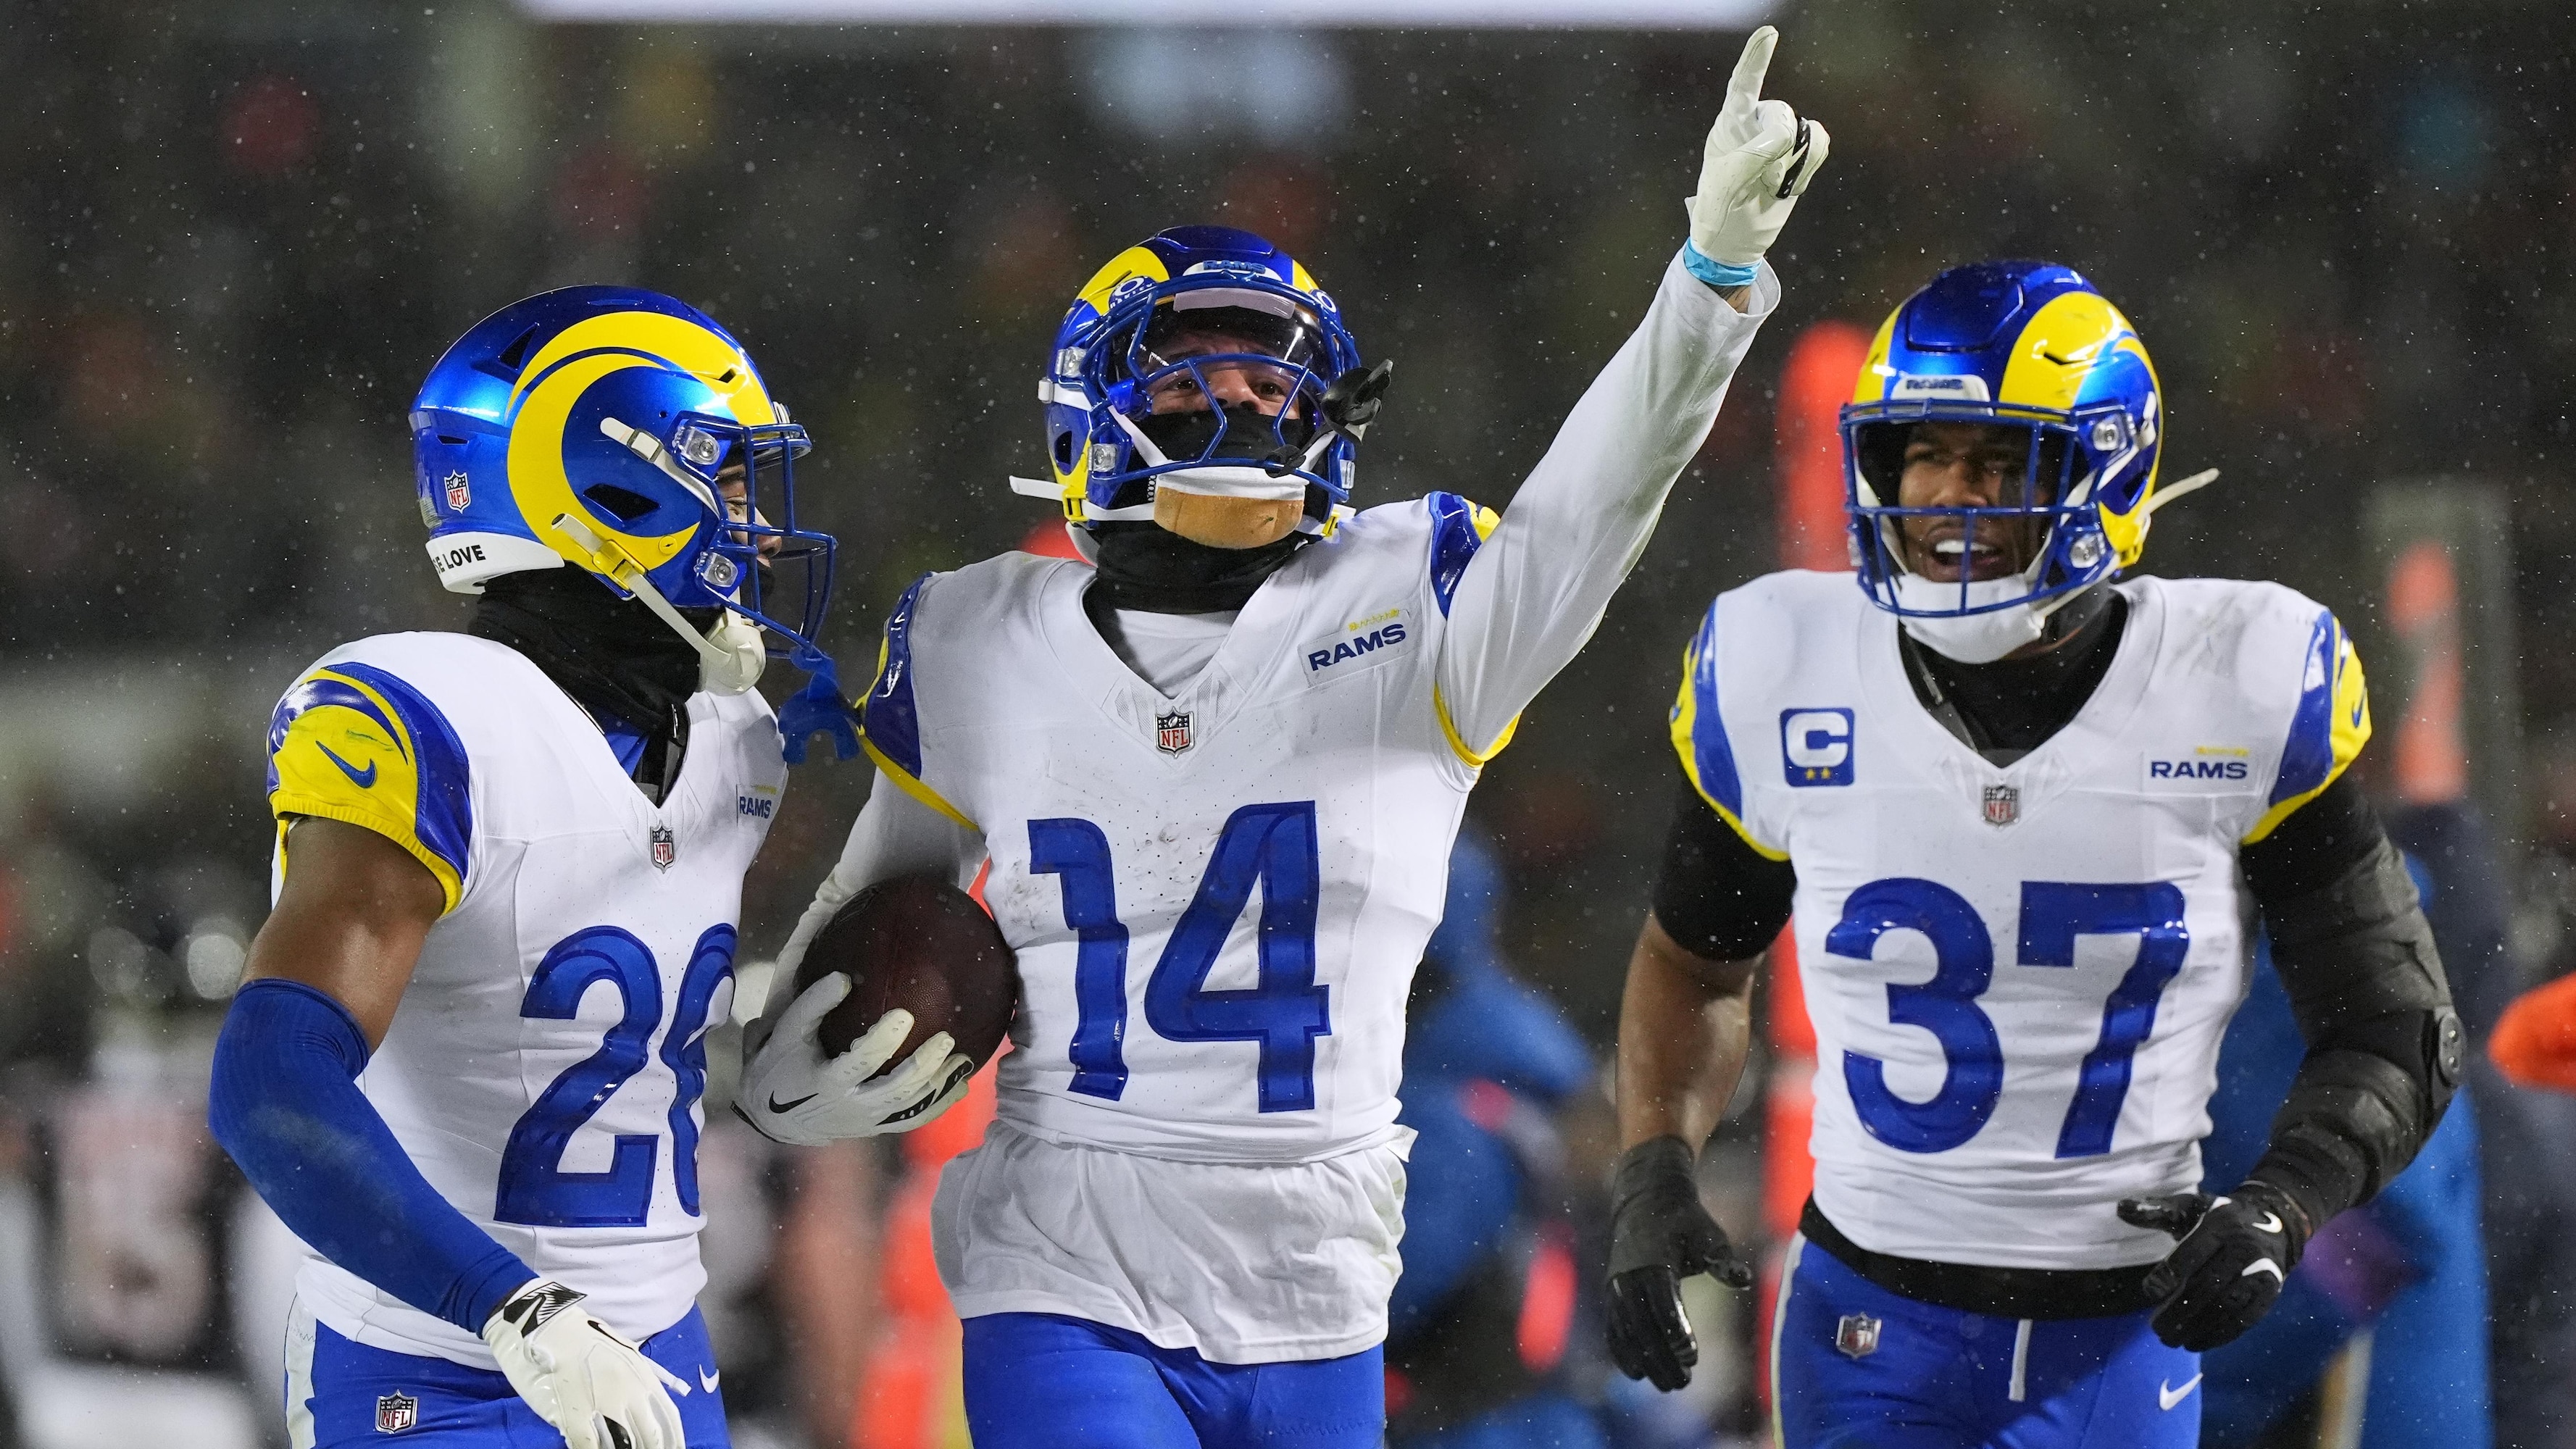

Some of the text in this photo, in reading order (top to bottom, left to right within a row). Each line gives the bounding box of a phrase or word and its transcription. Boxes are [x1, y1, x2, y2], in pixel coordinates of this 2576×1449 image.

[449, 488, 467, 506] NFL
[442, 545, 486, 569] LOVE
[1309, 623, 1406, 672] RAMS
[1161, 729, 1189, 748] NFL
[1785, 711, 1849, 768] C
[2151, 761, 2248, 779] RAMS
[738, 796, 772, 819] RAMS
[1988, 801, 2012, 820] NFL
[655, 843, 672, 862] NFL
[1027, 800, 1332, 1113] 14
[1825, 877, 2190, 1159] 37
[381, 1410, 408, 1429] NFL
